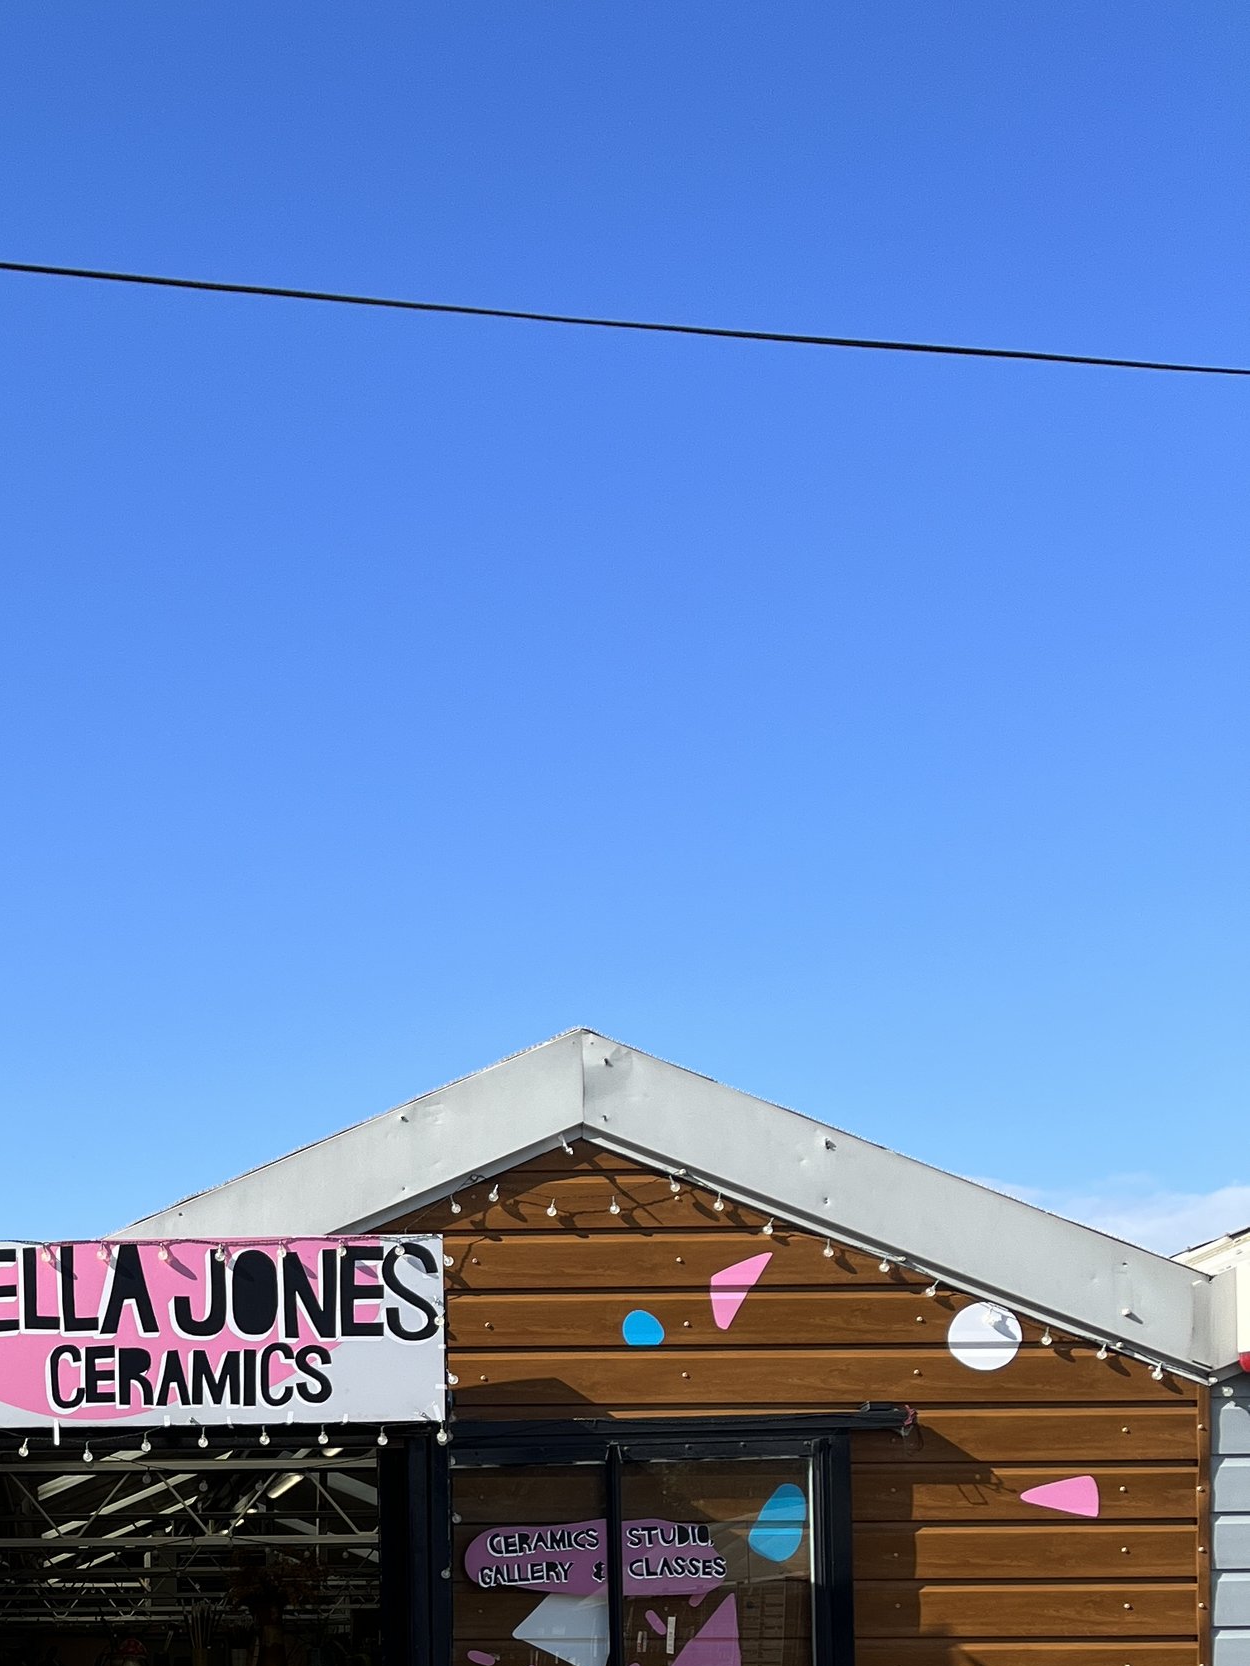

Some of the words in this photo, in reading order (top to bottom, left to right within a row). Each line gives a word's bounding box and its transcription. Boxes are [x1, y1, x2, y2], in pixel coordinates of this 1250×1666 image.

[172, 1243, 440, 1341] JONES
[50, 1343, 333, 1409] CERAMICS
[488, 1528, 600, 1557] CERAMICS
[479, 1561, 575, 1587] GALLERY
[592, 1561, 607, 1583] &
[628, 1556, 727, 1579] CLASSES
